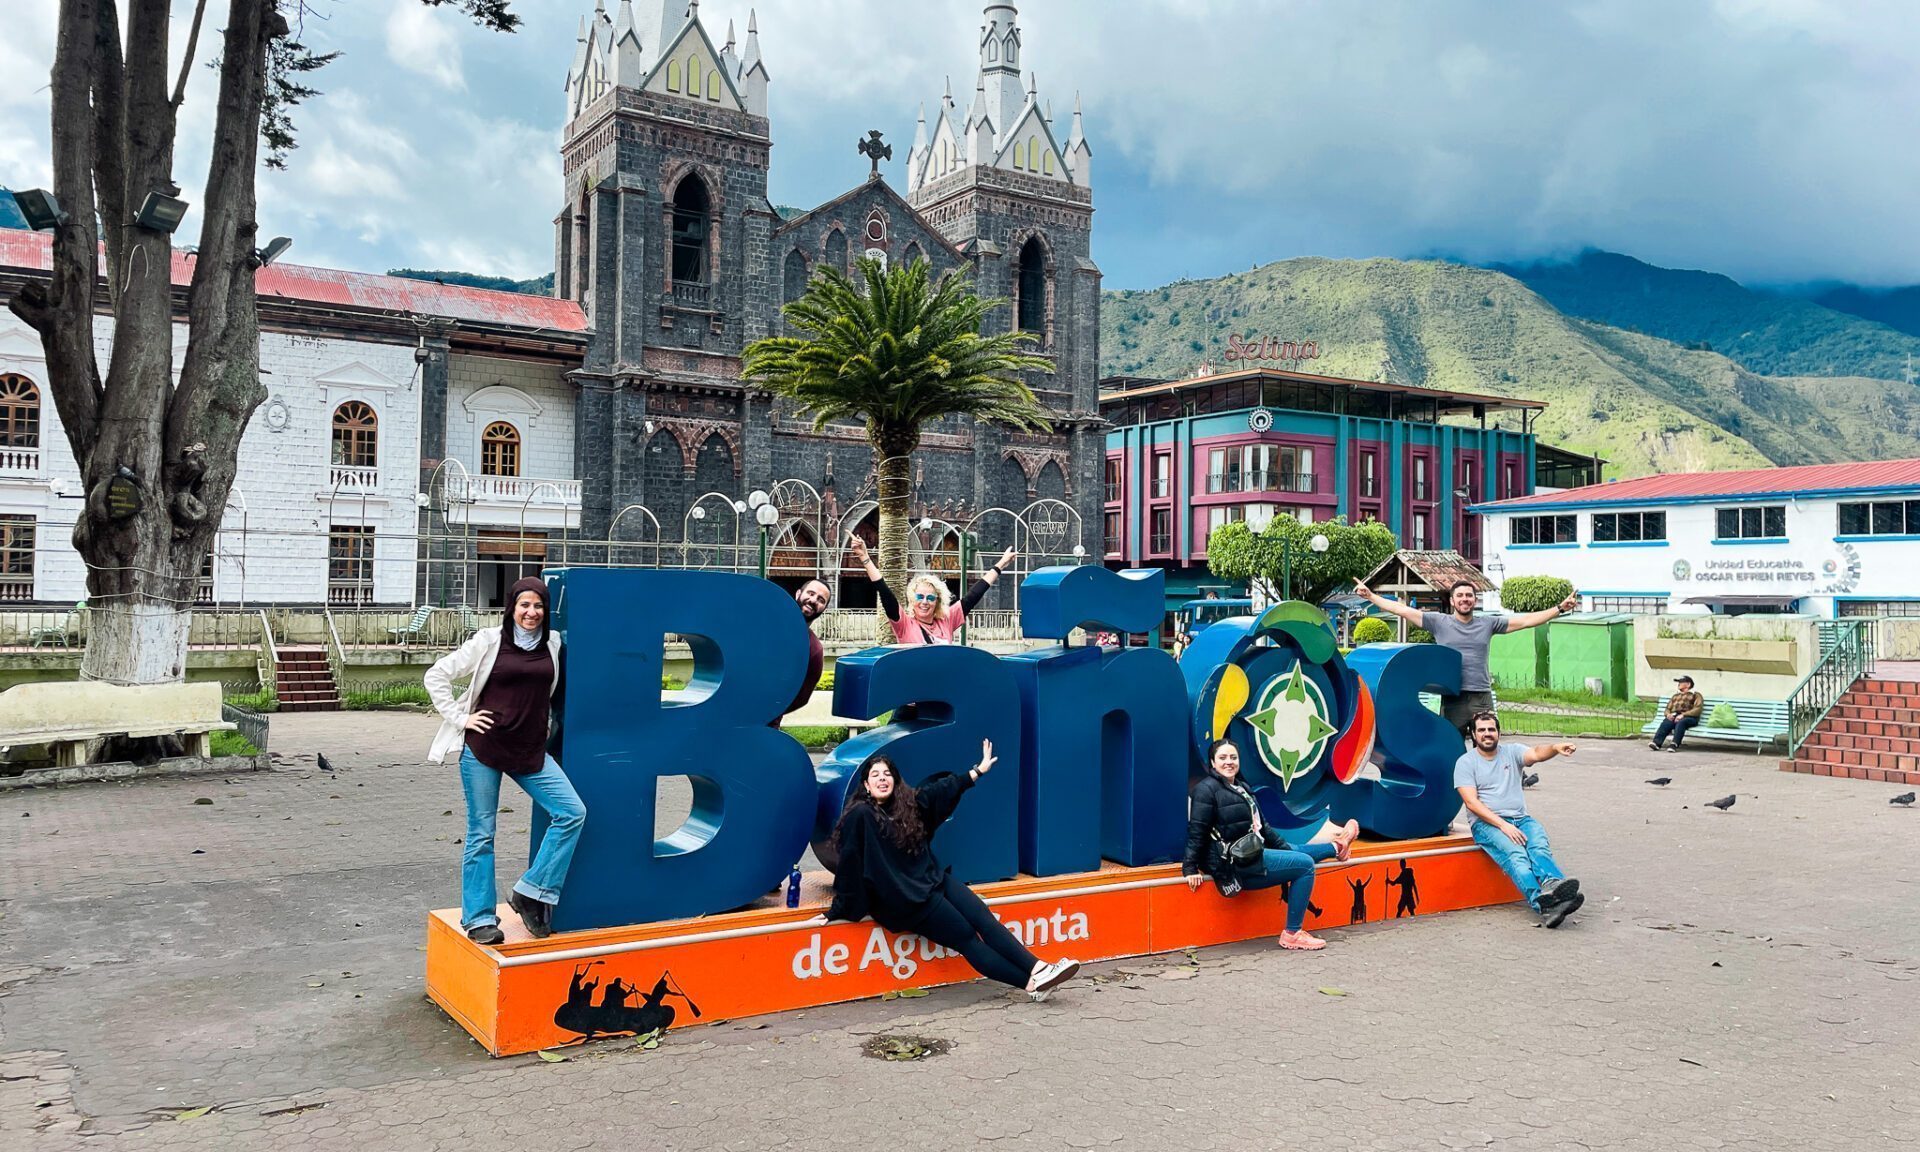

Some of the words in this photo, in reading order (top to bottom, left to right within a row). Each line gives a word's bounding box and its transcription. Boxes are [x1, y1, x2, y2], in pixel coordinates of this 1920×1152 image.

[1225, 333, 1320, 361] Selina
[1695, 572, 1733, 581] OSCAR
[1736, 572, 1774, 581] EFREN
[1777, 572, 1815, 581] REYES
[1705, 559, 1744, 569] Unidad
[530, 564, 1466, 933] Baños
[792, 933, 850, 980] de
[993, 906, 1090, 946] anta
